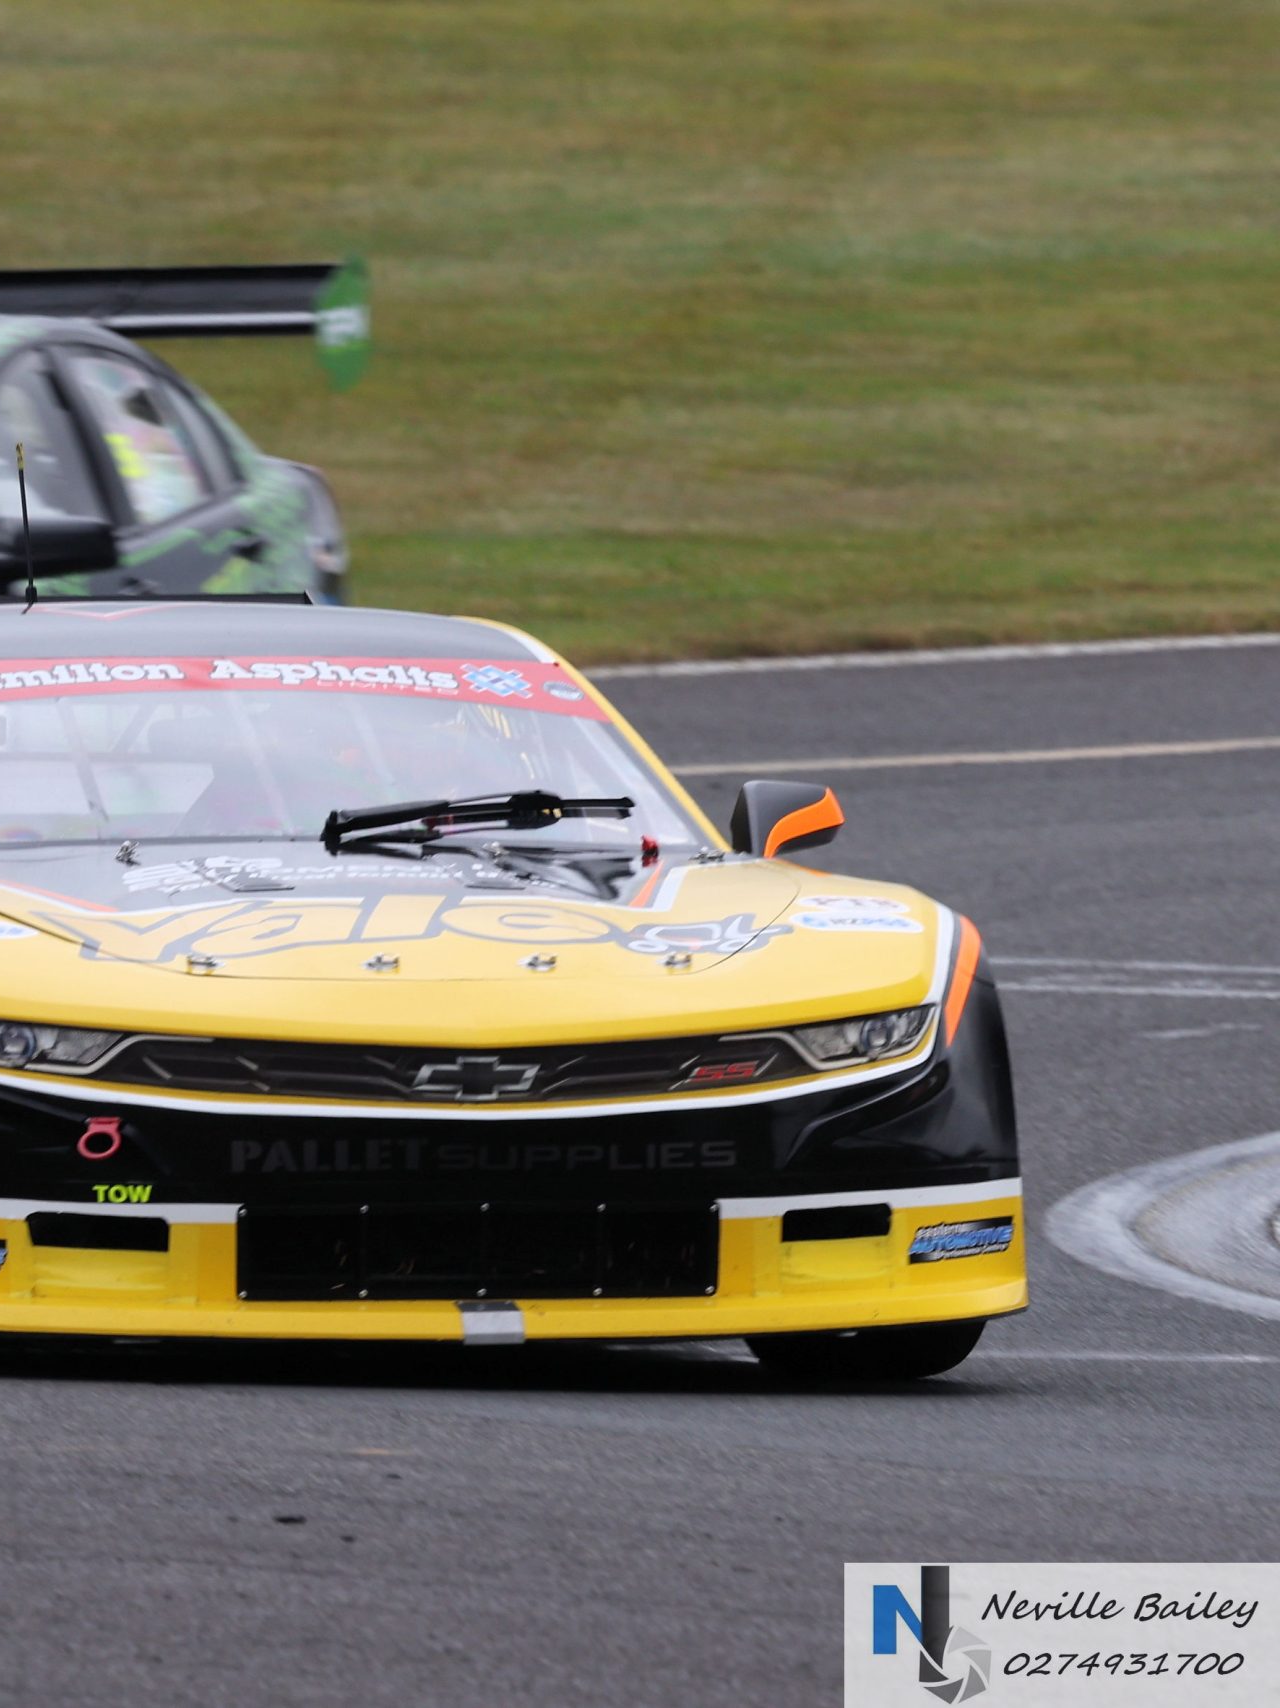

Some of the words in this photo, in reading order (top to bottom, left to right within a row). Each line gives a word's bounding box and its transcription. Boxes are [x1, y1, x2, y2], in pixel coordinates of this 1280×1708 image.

[209, 660, 460, 690] Asphalts
[28, 893, 618, 963] Yale
[229, 1139, 430, 1173] PALLET
[436, 1140, 739, 1171] SUPPLIES
[91, 1184, 153, 1203] TOW
